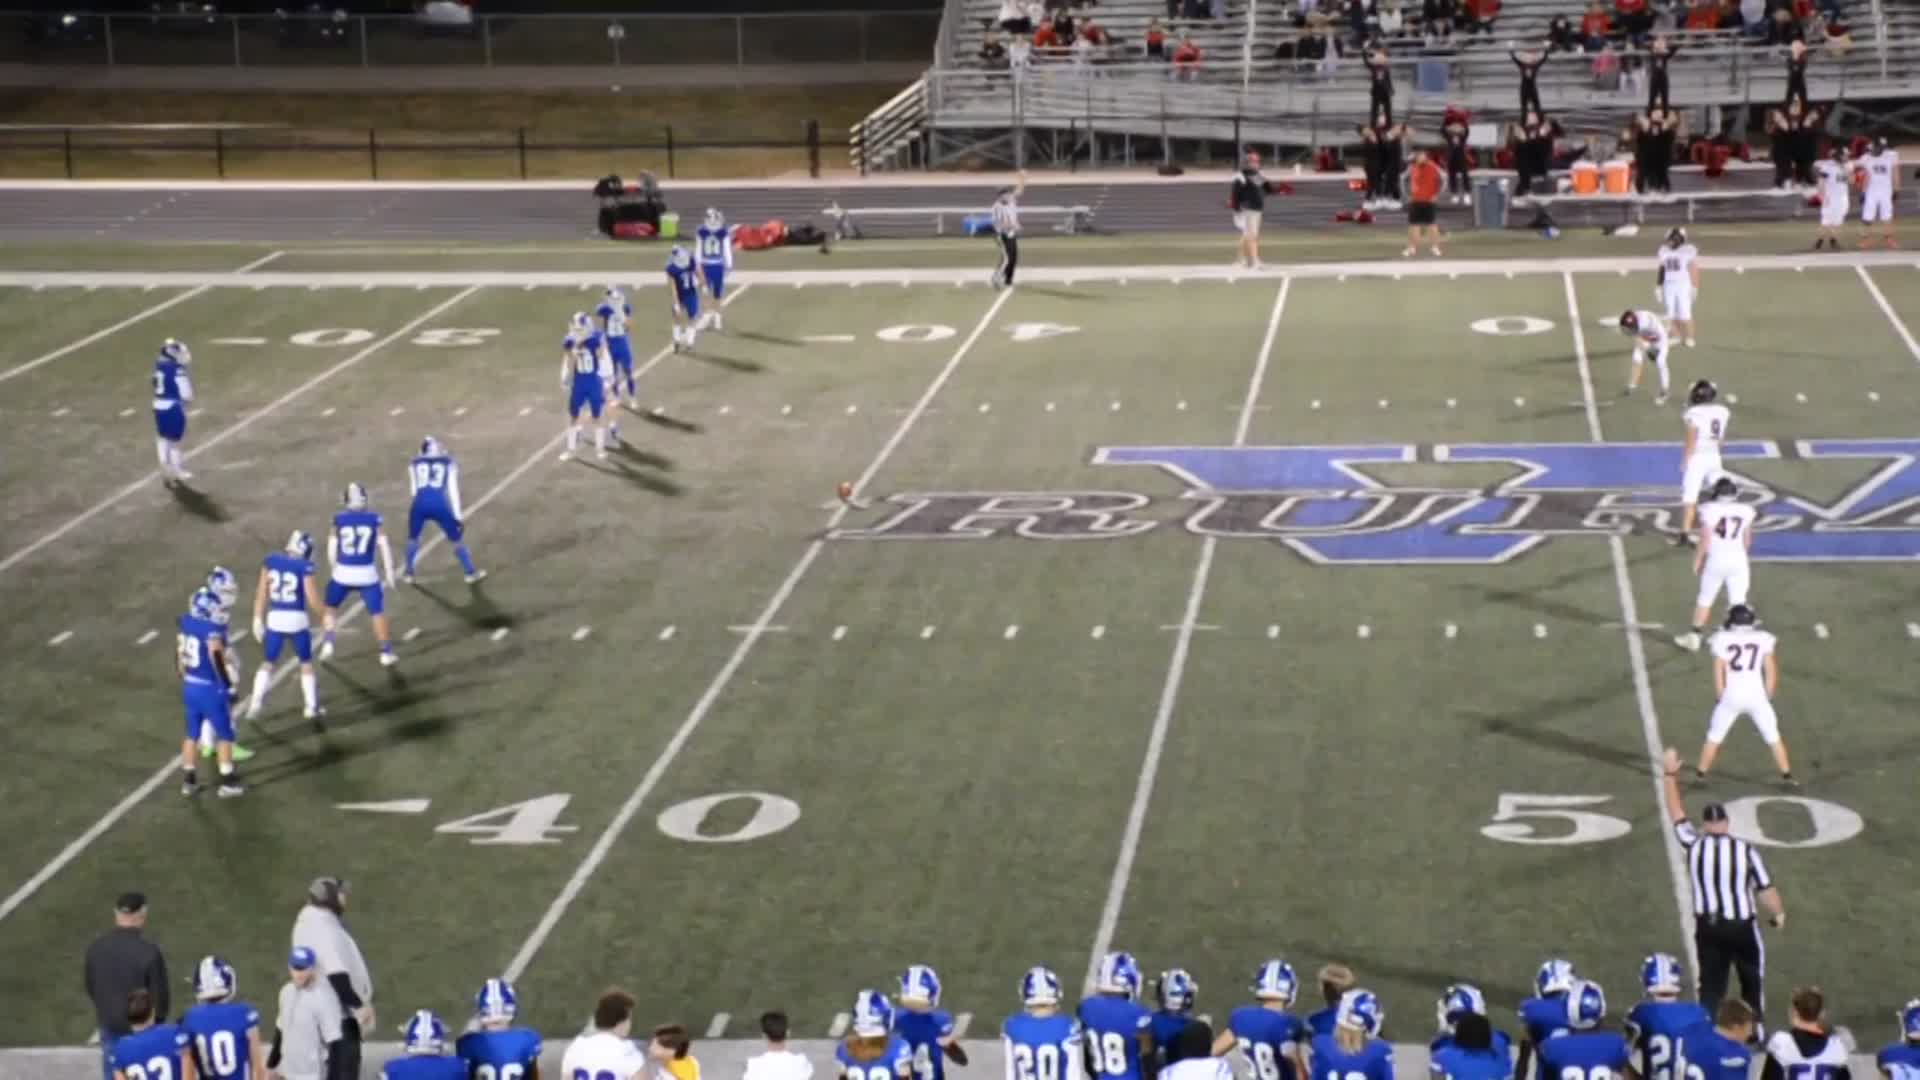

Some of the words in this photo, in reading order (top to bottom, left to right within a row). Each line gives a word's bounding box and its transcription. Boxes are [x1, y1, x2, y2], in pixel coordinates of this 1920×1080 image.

[340, 525, 374, 555] 27
[1715, 515, 1743, 539] 47
[268, 568, 298, 603] 22
[1727, 643, 1759, 671] 27
[434, 793, 801, 845] 40
[1480, 794, 1863, 848] 50
[195, 1030, 236, 1076] 10
